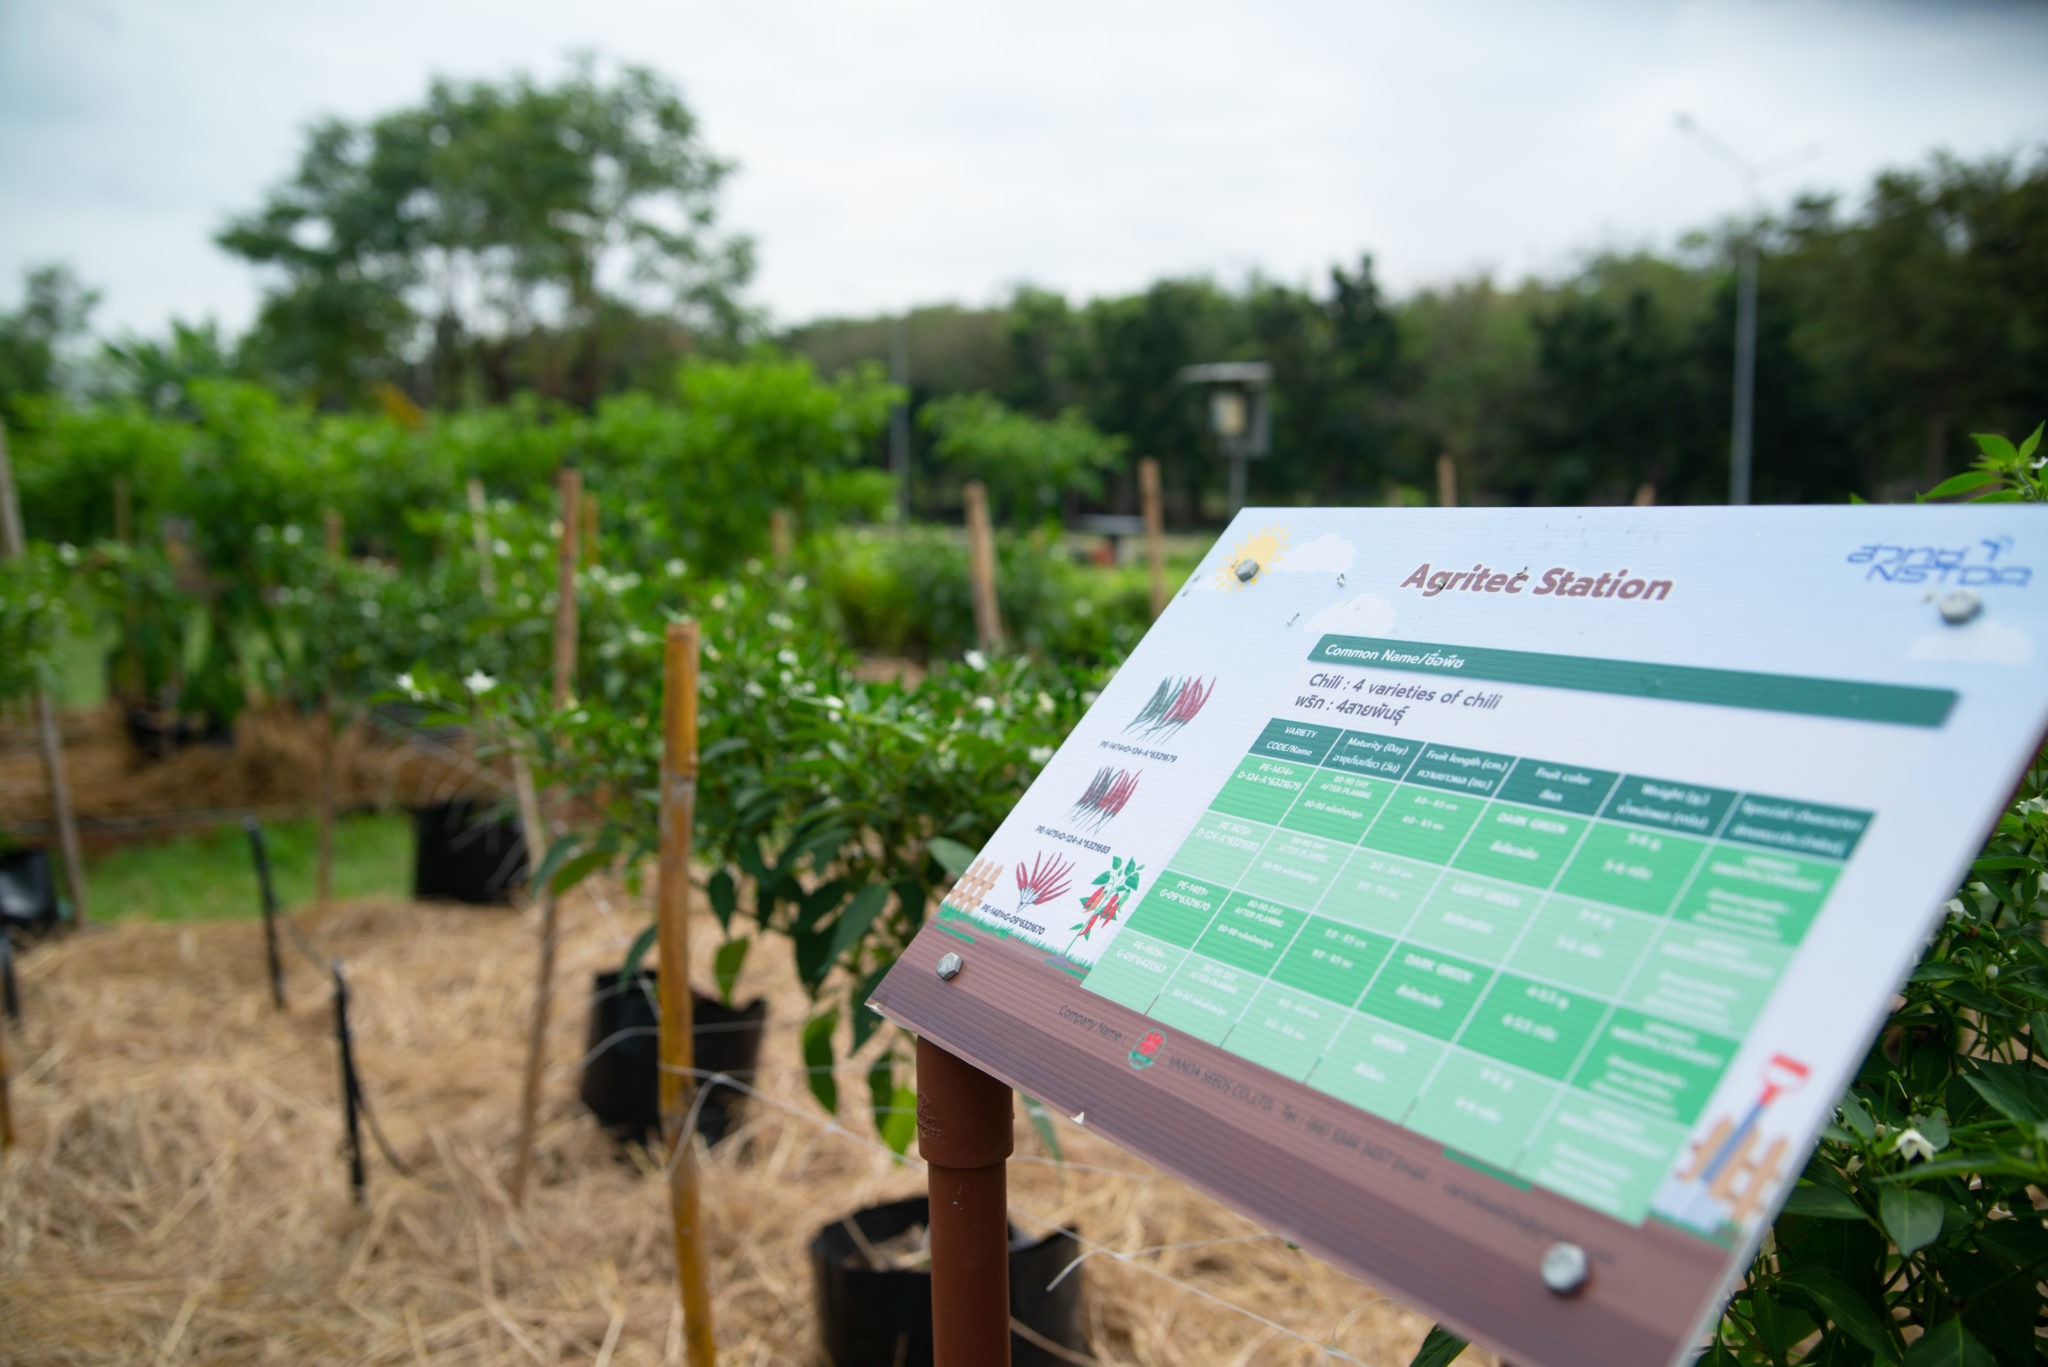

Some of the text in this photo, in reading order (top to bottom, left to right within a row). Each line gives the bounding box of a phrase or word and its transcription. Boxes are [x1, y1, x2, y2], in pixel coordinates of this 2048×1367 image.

[1400, 563, 1674, 601] Agritec Station
[1324, 643, 1380, 661] Common
[1308, 672, 1345, 690] Chili
[1352, 677, 1367, 693] 4
[1367, 682, 1437, 702] varieties
[1439, 689, 1464, 705] of
[1462, 691, 1504, 710] chili
[1294, 693, 1326, 710] พริก
[1335, 698, 1411, 727] 4สายพันธุ์
[1282, 726, 1318, 739] VARIETY
[1263, 740, 1315, 757] CODE/Name
[1344, 736, 1411, 756] Maturity (Day)
[1424, 749, 1450, 761] Fruit
[1446, 753, 1483, 769] length
[1055, 1004, 1099, 1032] Company
[1094, 1022, 1124, 1042] Name
